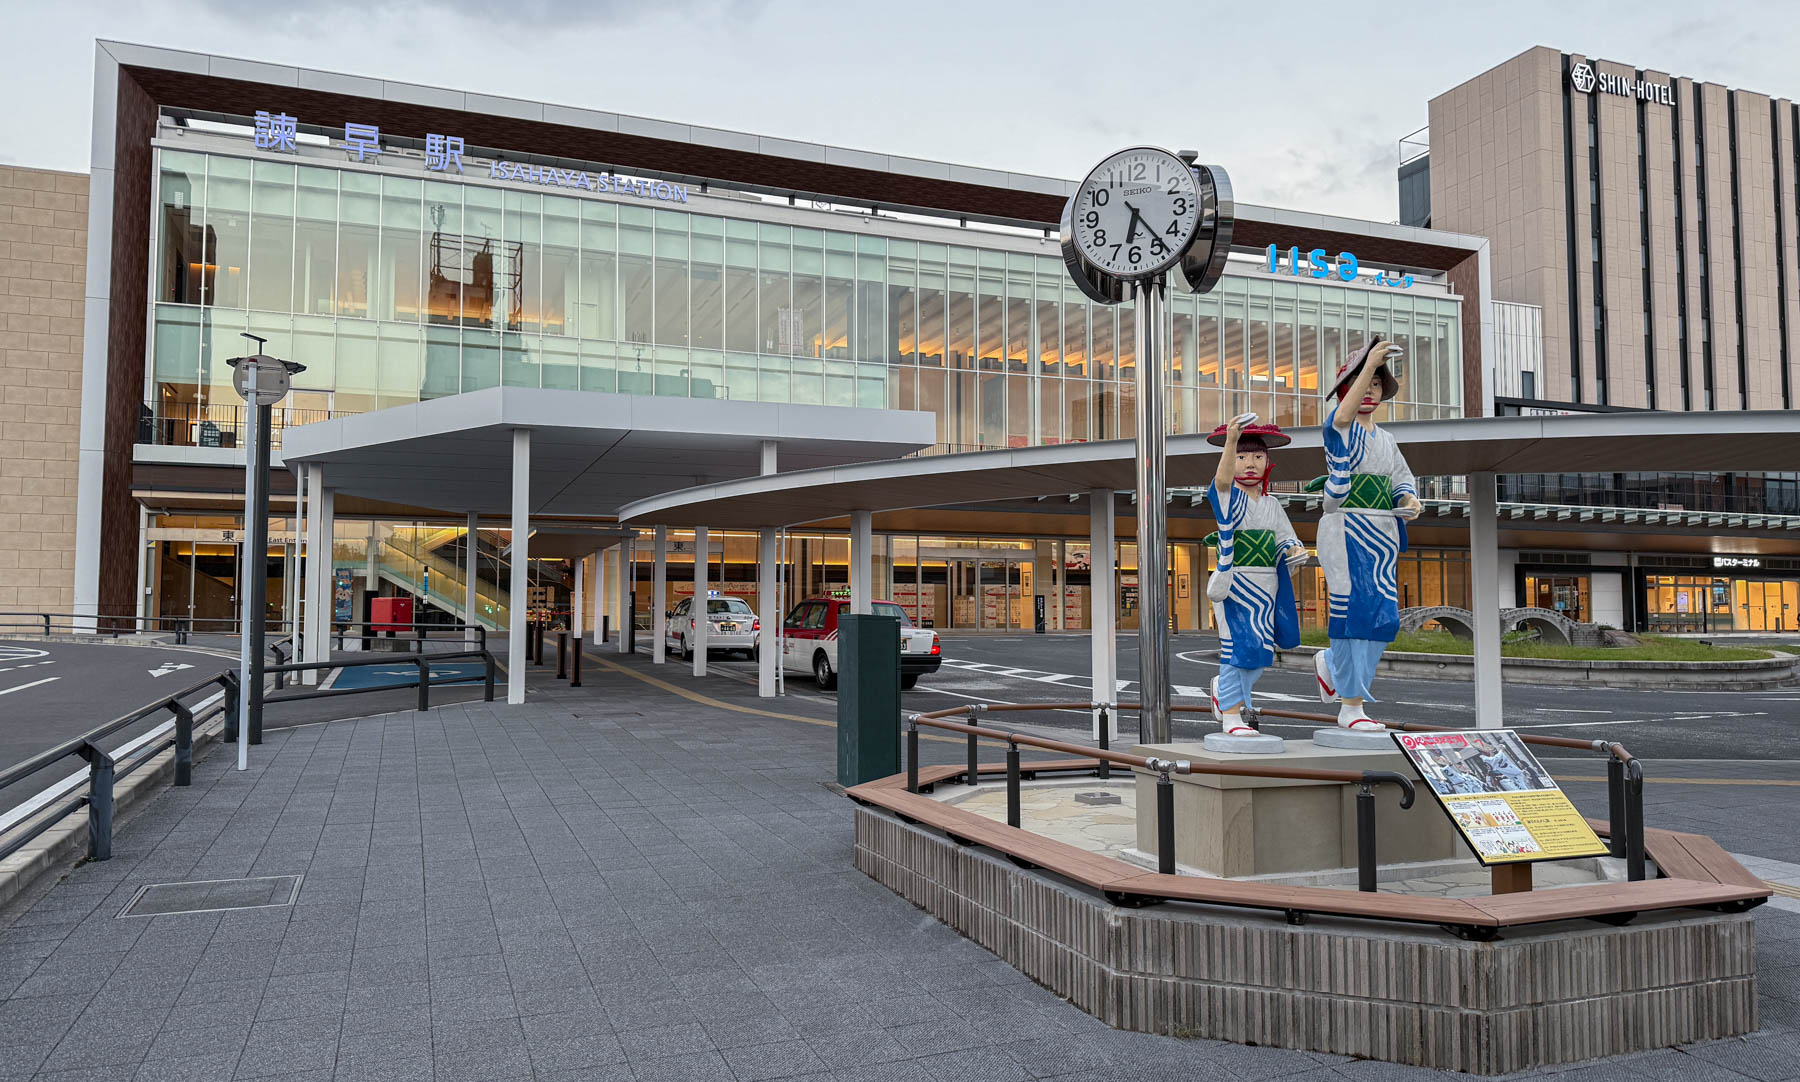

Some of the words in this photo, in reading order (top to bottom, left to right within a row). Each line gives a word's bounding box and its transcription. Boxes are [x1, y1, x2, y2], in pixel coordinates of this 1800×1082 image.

[1599, 72, 1676, 106] SHIN-HOTEL
[254, 110, 465, 175] 諫早駅
[490, 160, 591, 191] ISAHAYA
[599, 174, 687, 202] STATION
[1109, 170, 1123, 189] 11
[1127, 163, 1146, 181] 12
[1123, 186, 1152, 197] SEIKO
[1167, 176, 1180, 195] 2
[1091, 188, 1110, 207] 10
[1172, 198, 1187, 216] 3
[1085, 211, 1099, 229] 9
[1165, 219, 1180, 237] 4
[1093, 229, 1106, 247] 8
[1150, 238, 1163, 256] 5
[1109, 243, 1122, 261] 7
[1128, 246, 1142, 264] 6
[268, 536, 283, 544] East
[1721, 557, 1760, 567] バスターミナル
